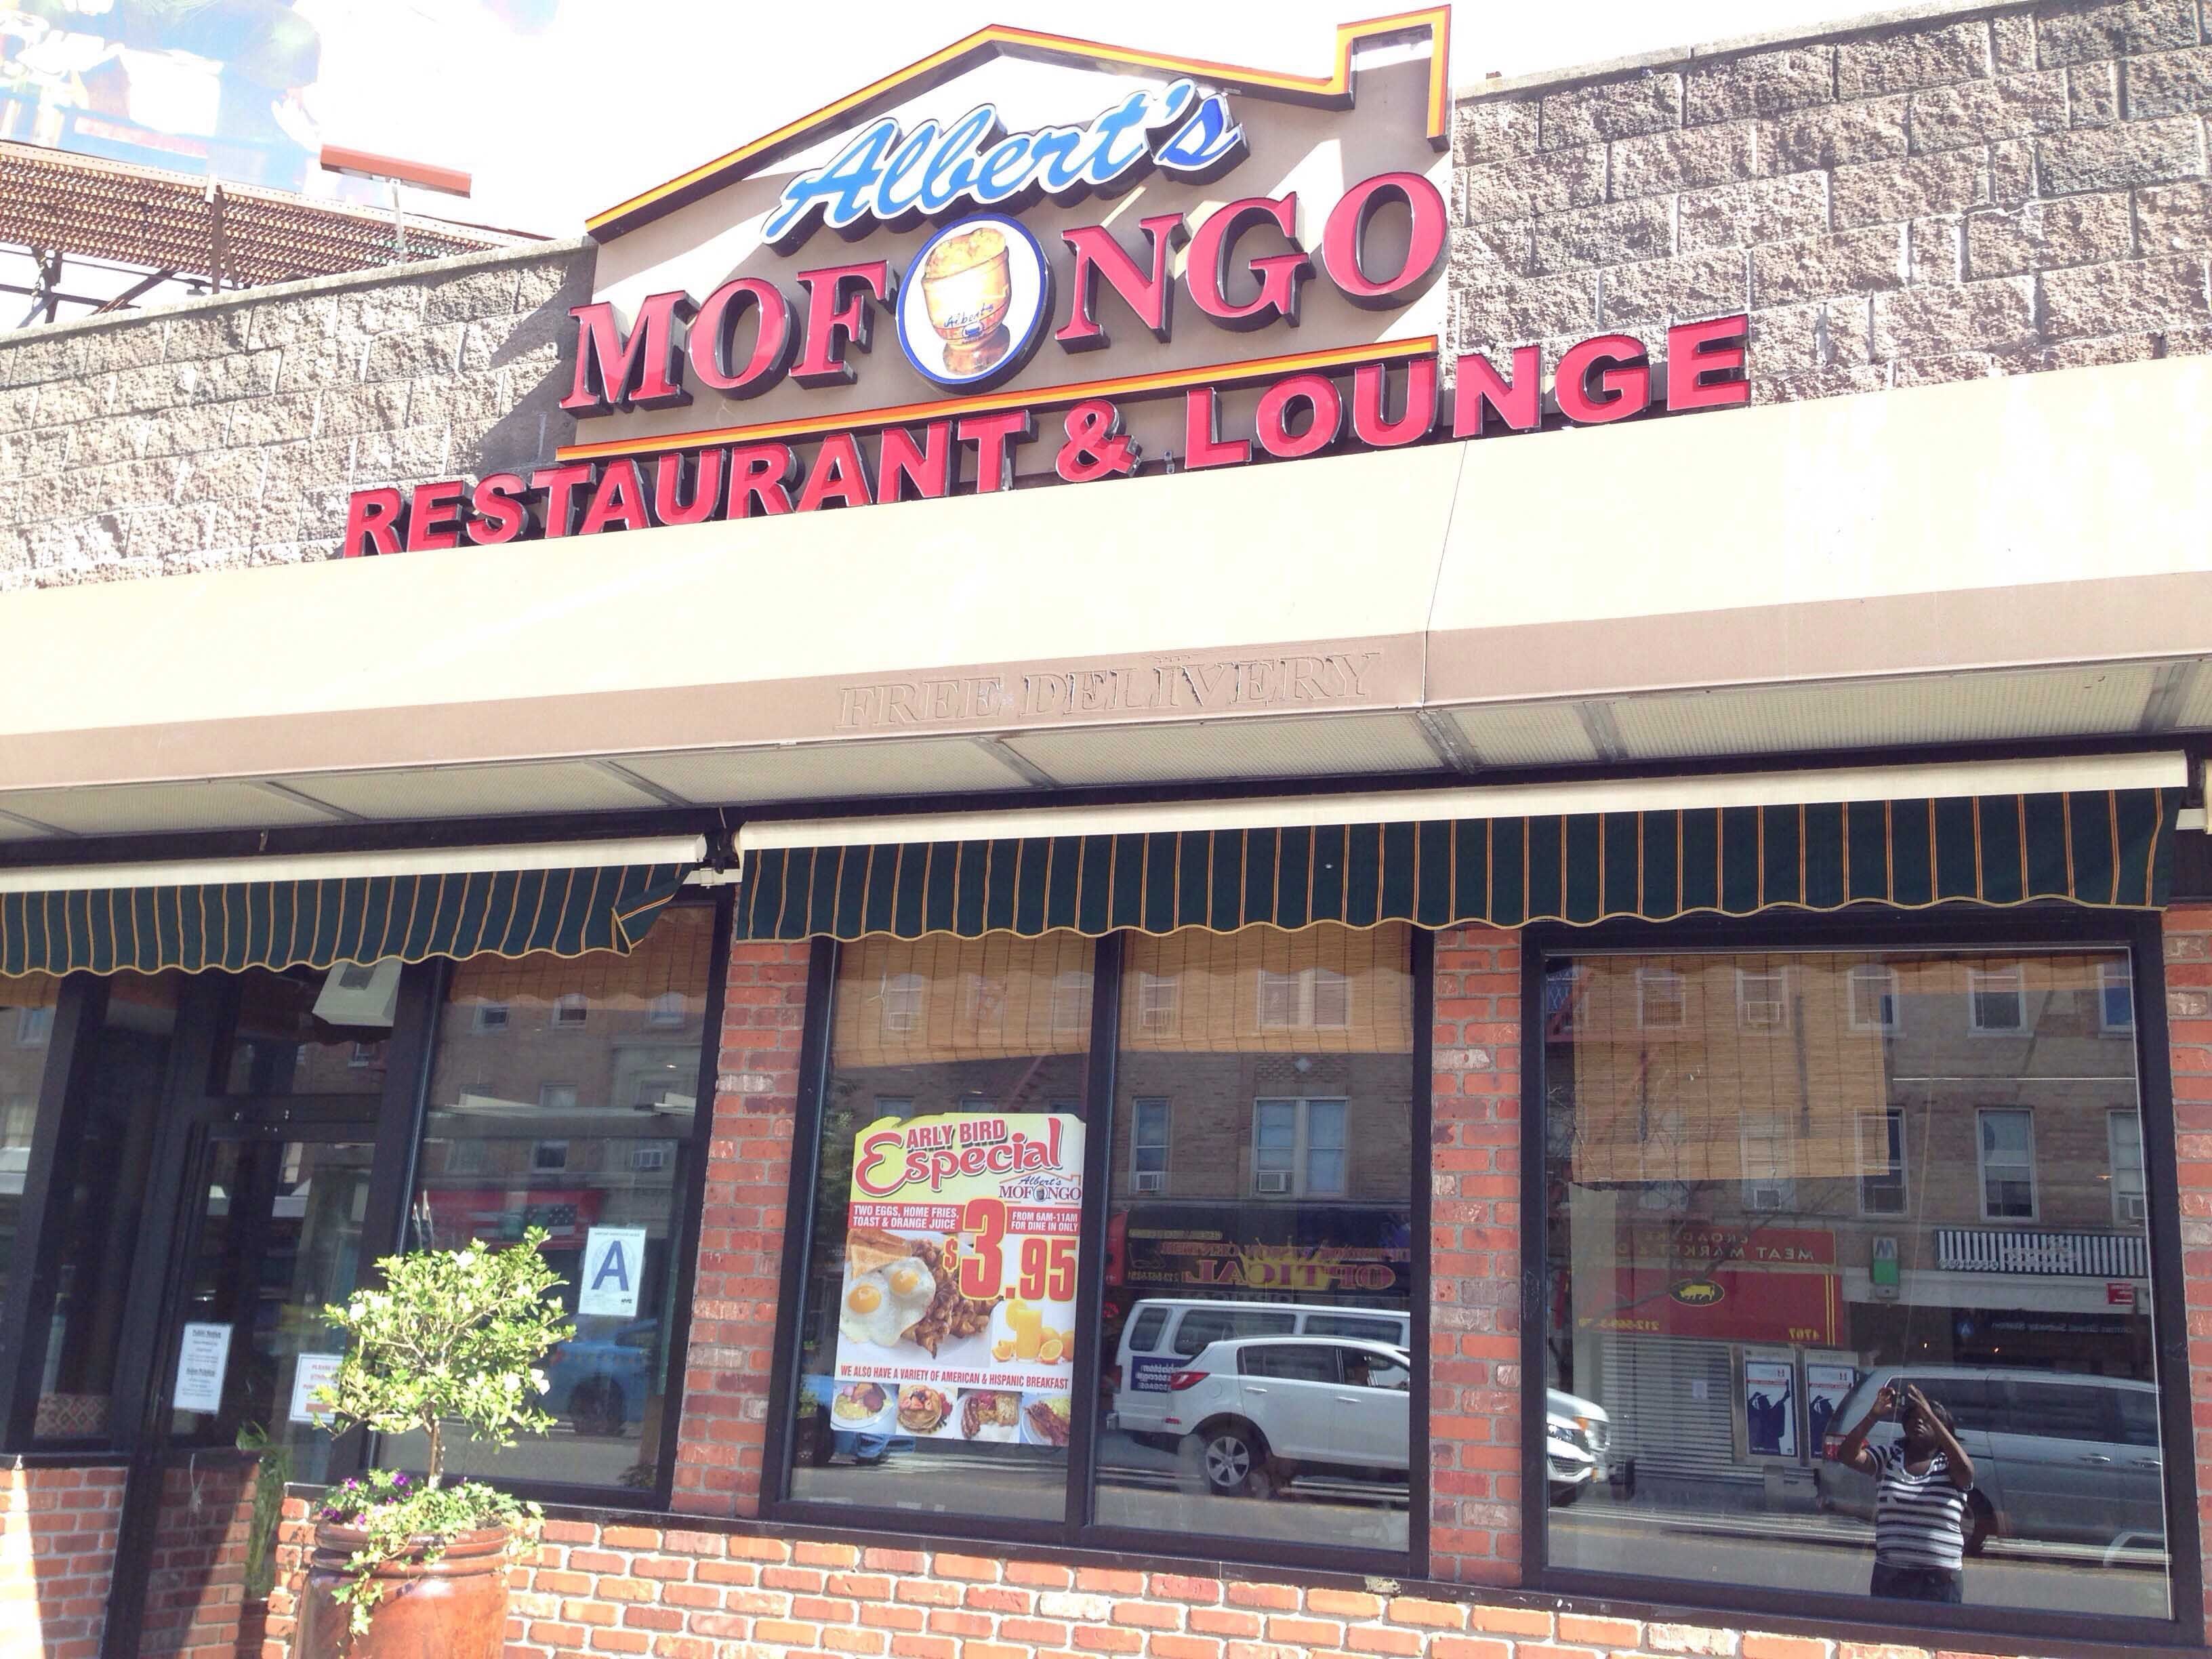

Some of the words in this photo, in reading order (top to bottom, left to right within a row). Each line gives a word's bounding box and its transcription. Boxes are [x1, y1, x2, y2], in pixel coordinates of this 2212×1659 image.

[760, 77, 1246, 247] Albert's
[344, 411, 1030, 560] RESTAURANT
[1055, 401, 1138, 481] &
[1185, 313, 1750, 470] LOUNGE
[835, 676, 1001, 729] FREE
[1019, 652, 1381, 716] DELIVERY
[960, 1119, 1008, 1144] BIRD
[855, 1117, 1063, 1197] Especial
[1018, 1176, 1062, 1185] Albert's
[853, 1216, 879, 1227] TOAST
[882, 1217, 889, 1227] &
[891, 1217, 927, 1229] ORANGE
[929, 1218, 956, 1229] JUICE
[854, 1205, 873, 1216] TWO
[876, 1206, 901, 1218] EGGS,
[903, 1206, 929, 1217] HOME
[932, 1207, 959, 1219] FRIES,
[1012, 1211, 1034, 1221] FROM
[1036, 1211, 1078, 1222] 6AM-11AM
[1011, 1221, 1027, 1230] FOR
[1028, 1221, 1046, 1231] DINE
[1048, 1222, 1057, 1231] IN
[1059, 1223, 1078, 1232] ONLY
[590, 1240, 629, 1292] A
[841, 1365, 852, 1376] WE
[854, 1366, 872, 1377] ALSO
[874, 1367, 892, 1378] HAVE
[893, 1368, 898, 1379] A
[900, 1368, 928, 1381] VARIETY
[930, 1370, 939, 1381] OF
[941, 1371, 980, 1384] AMERICAN
[982, 1373, 987, 1385] &
[989, 1374, 1025, 1387] HISPANIC
[1026, 1376, 1069, 1389] BREAKFAST
